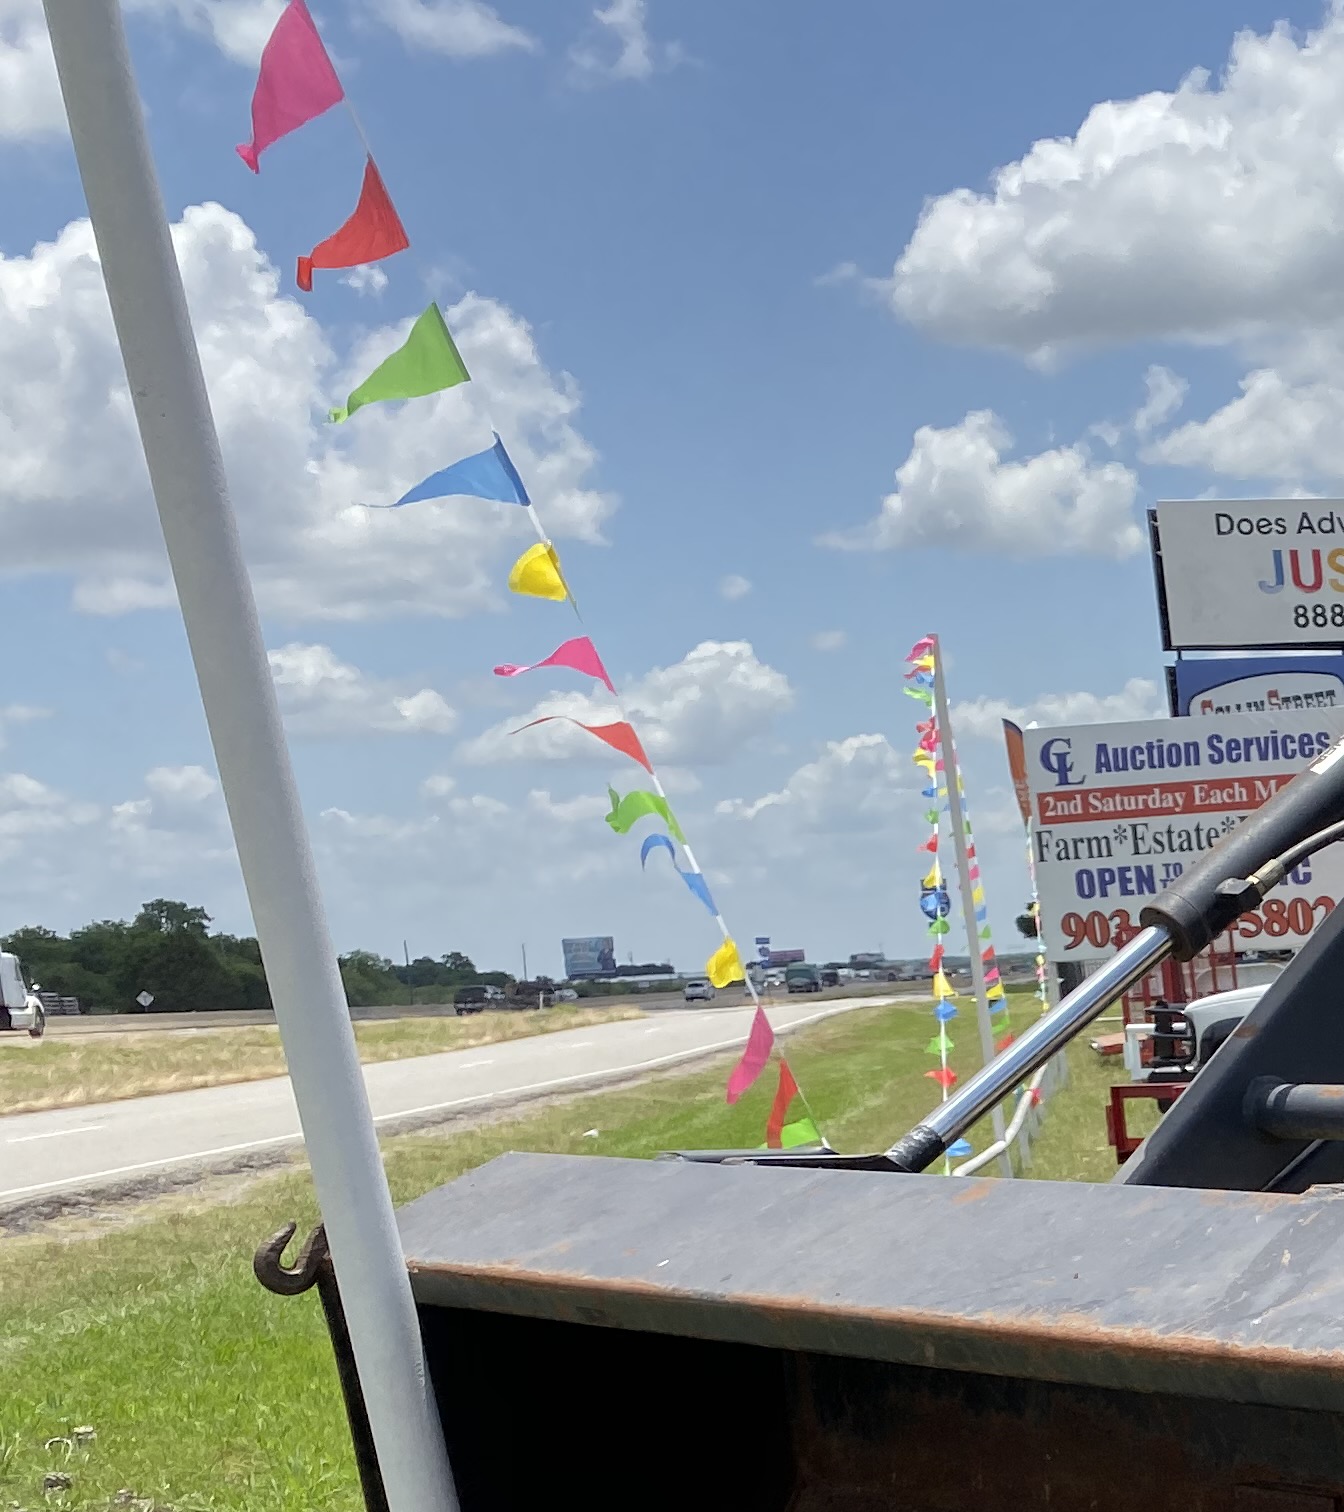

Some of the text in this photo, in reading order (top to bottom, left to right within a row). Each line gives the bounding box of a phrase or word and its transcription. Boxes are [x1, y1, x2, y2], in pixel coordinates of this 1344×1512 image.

[1215, 511, 1288, 536] Does
[1095, 739, 1201, 774] Auction
[1207, 730, 1330, 765] Services
[1043, 795, 1083, 818] 2nd
[1088, 787, 1187, 813] Saturday
[1193, 781, 1249, 805] Each
[1075, 864, 1157, 900] OPEN
[1161, 862, 1184, 879] TO
